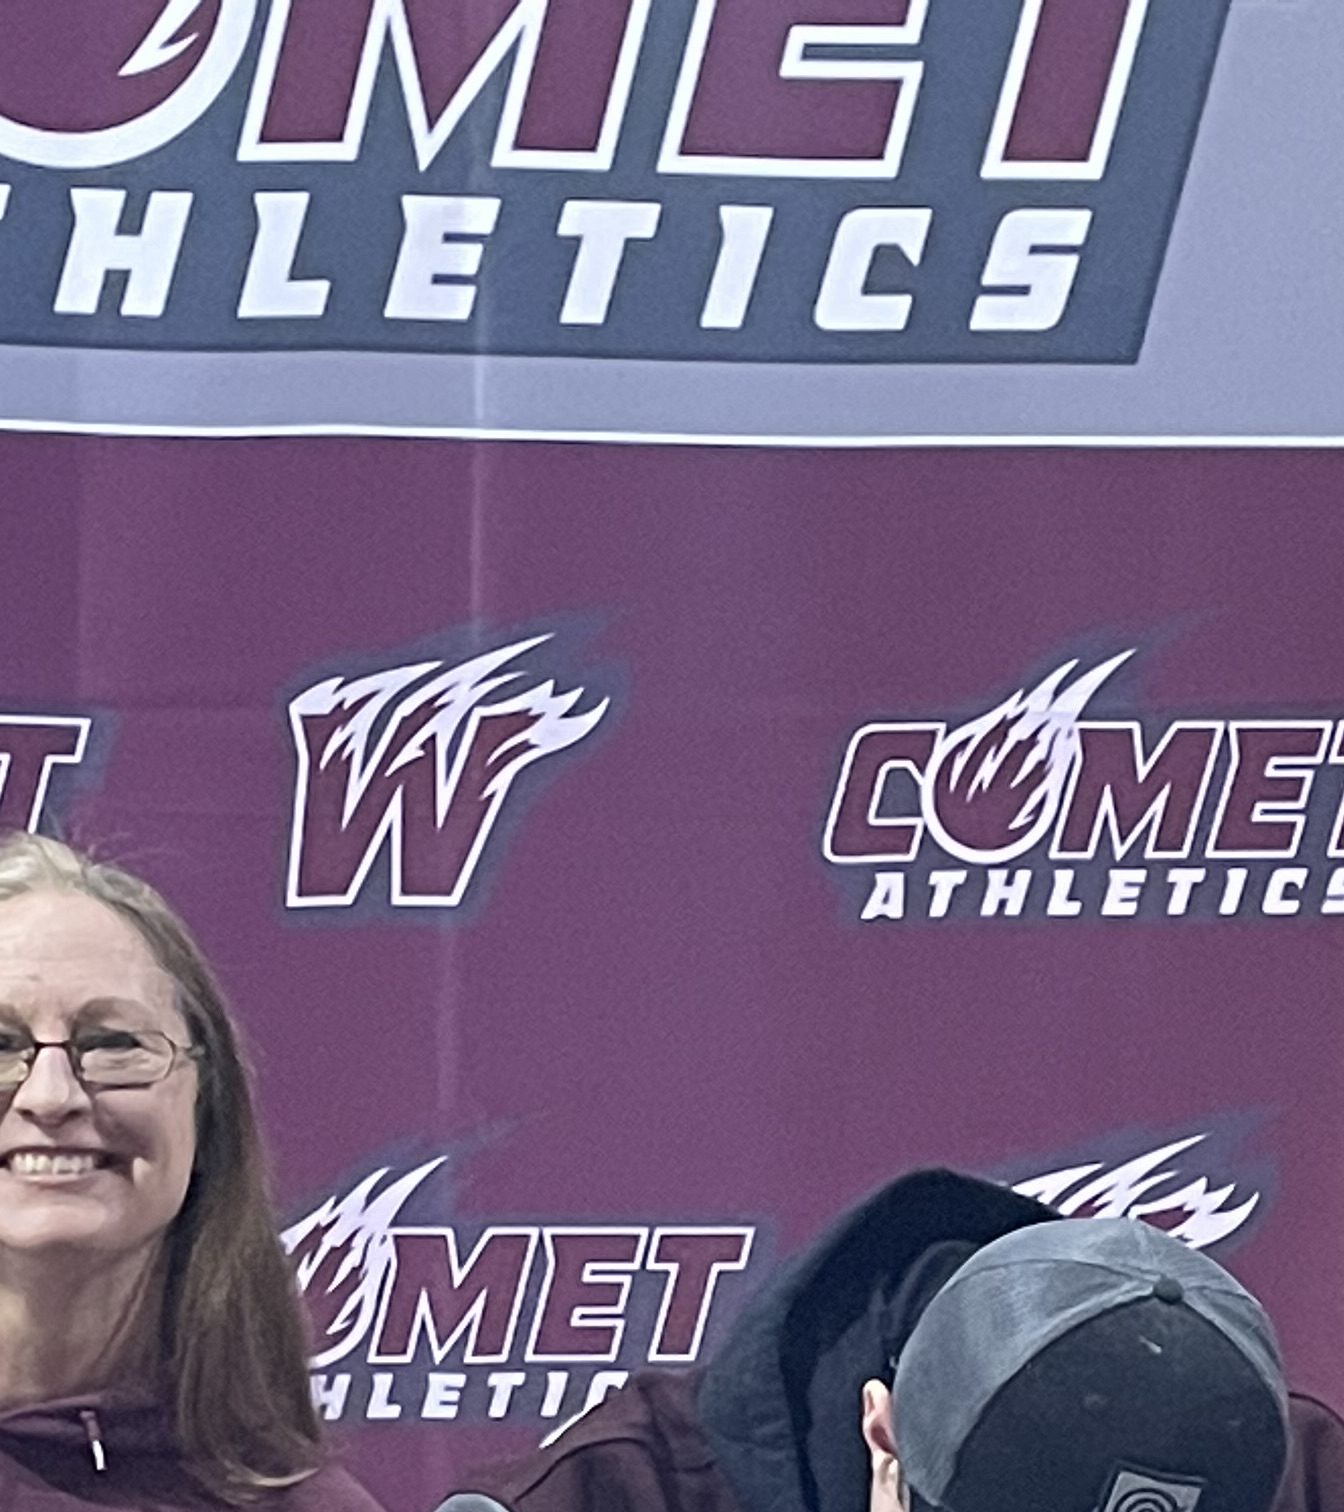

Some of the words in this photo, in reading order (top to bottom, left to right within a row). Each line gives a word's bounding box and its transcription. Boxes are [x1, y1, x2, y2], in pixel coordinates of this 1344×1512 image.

[286, 632, 610, 908] W
[279, 1154, 755, 1369] OMET
[309, 1371, 630, 1420] HLETI
